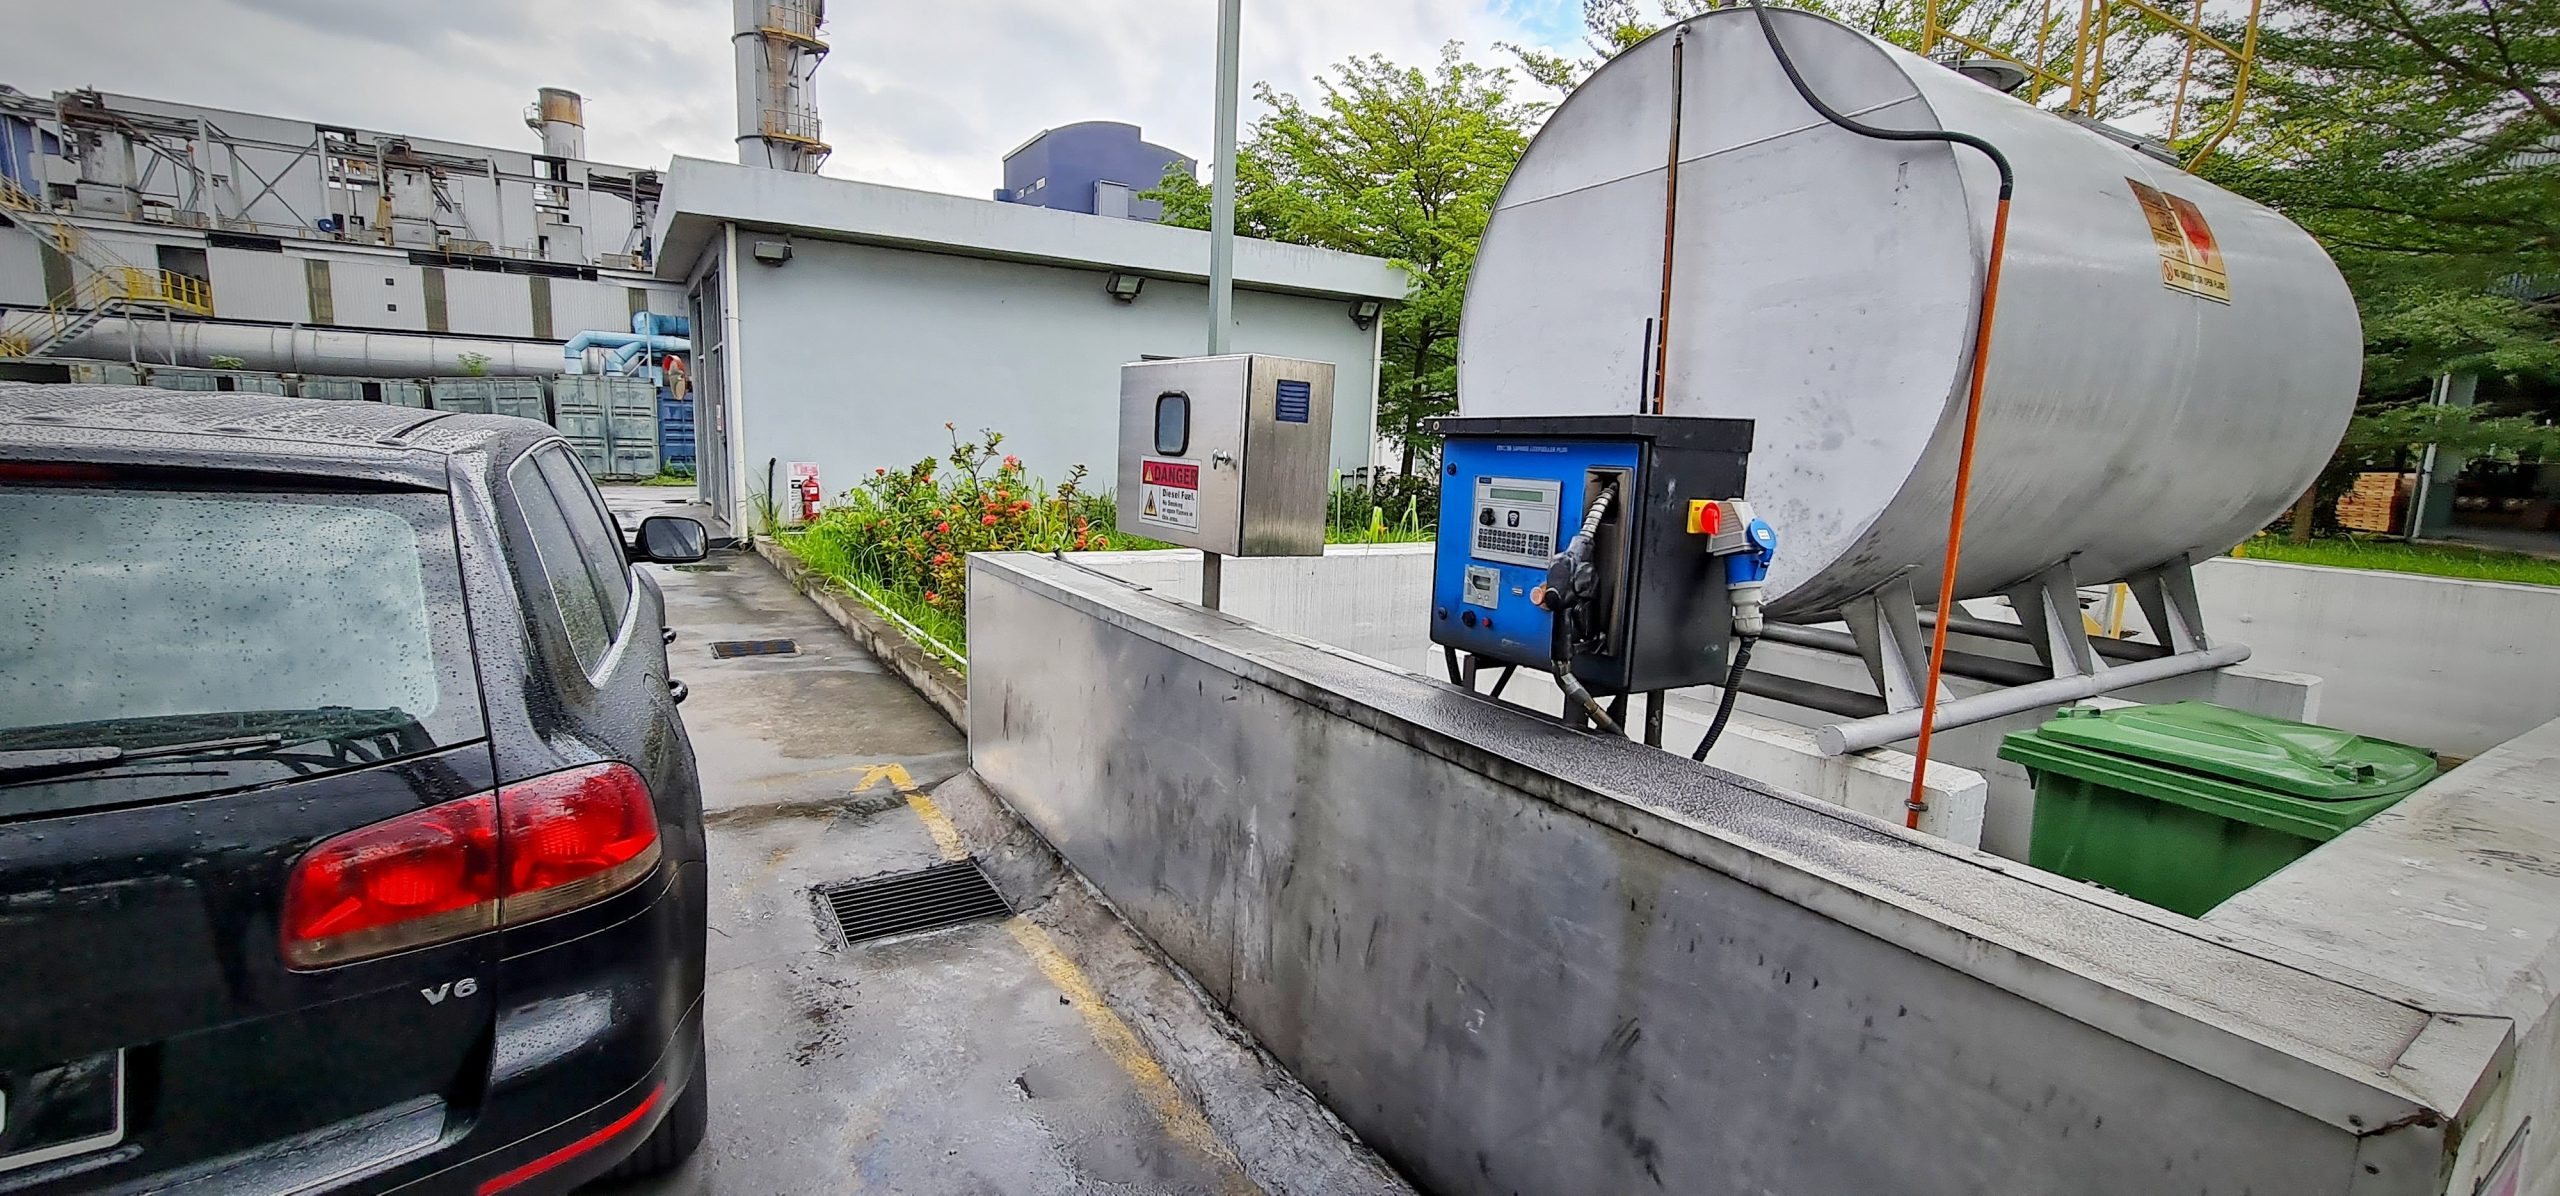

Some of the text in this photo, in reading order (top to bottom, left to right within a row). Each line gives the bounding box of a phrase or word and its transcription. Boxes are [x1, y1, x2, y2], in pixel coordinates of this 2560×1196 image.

[1154, 465, 1198, 486] DANGER
[1162, 488, 1180, 499] Diesel
[420, 977, 478, 1006] V6
